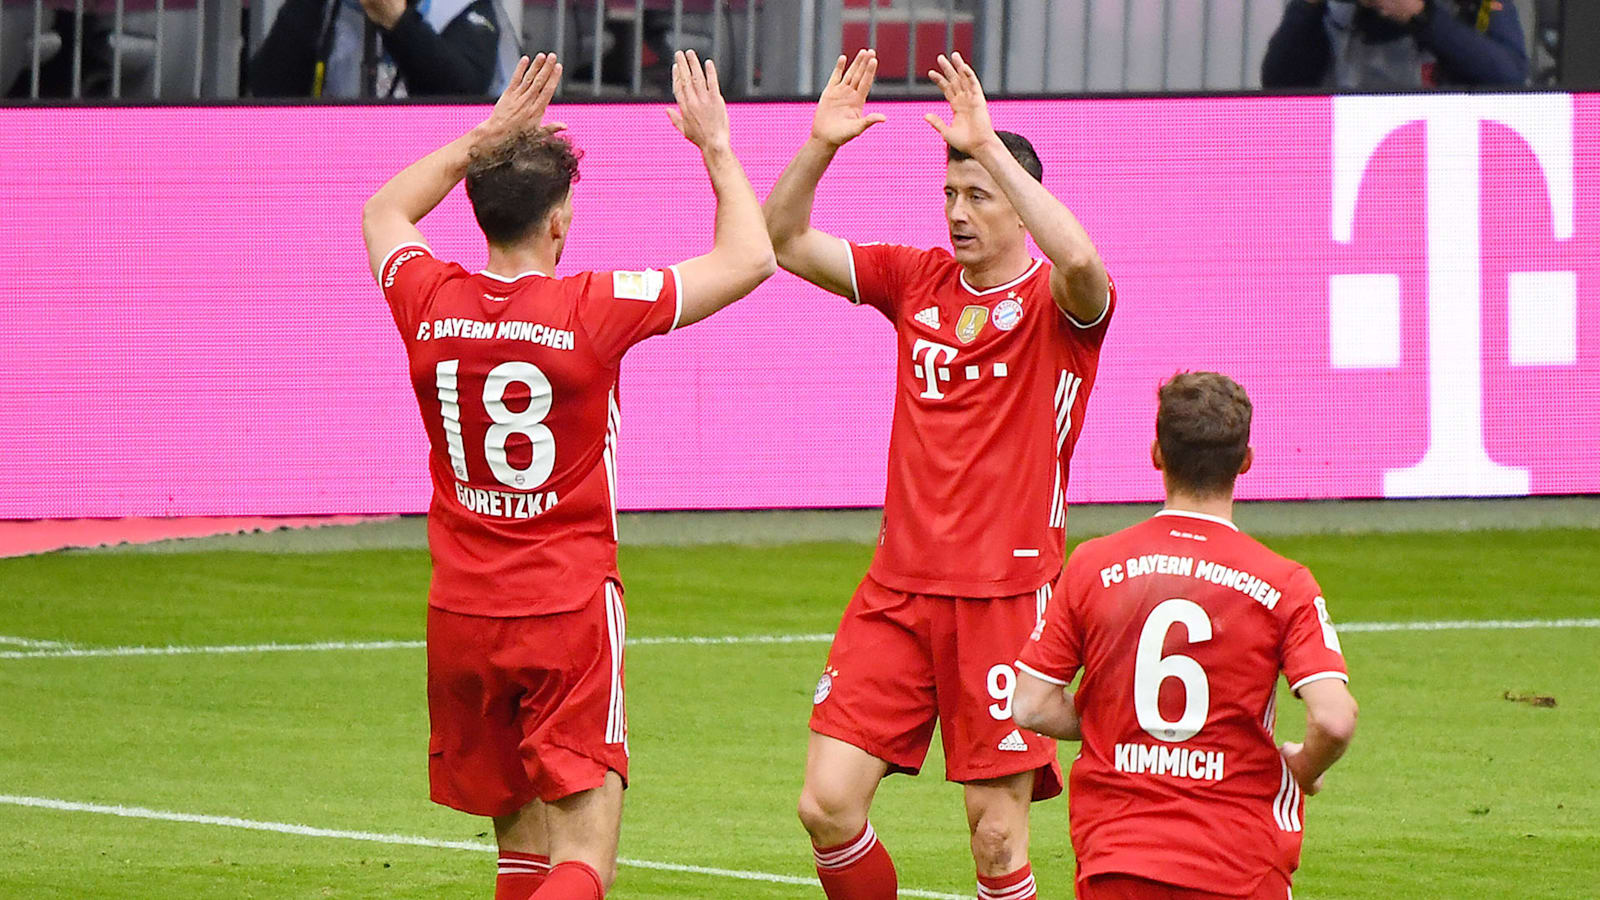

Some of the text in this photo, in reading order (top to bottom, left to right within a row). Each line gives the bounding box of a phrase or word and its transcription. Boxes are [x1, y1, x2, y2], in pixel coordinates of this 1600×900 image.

[1331, 93, 1575, 498] T
[433, 317, 497, 340] BAYERN
[435, 358, 557, 491] 18
[455, 481, 559, 519] GORETZKA
[1100, 563, 1125, 588] FC
[1126, 553, 1194, 579] BAYERN
[986, 664, 1017, 721] 9
[1133, 598, 1213, 743] 6
[1114, 743, 1225, 781] KIMMICH
